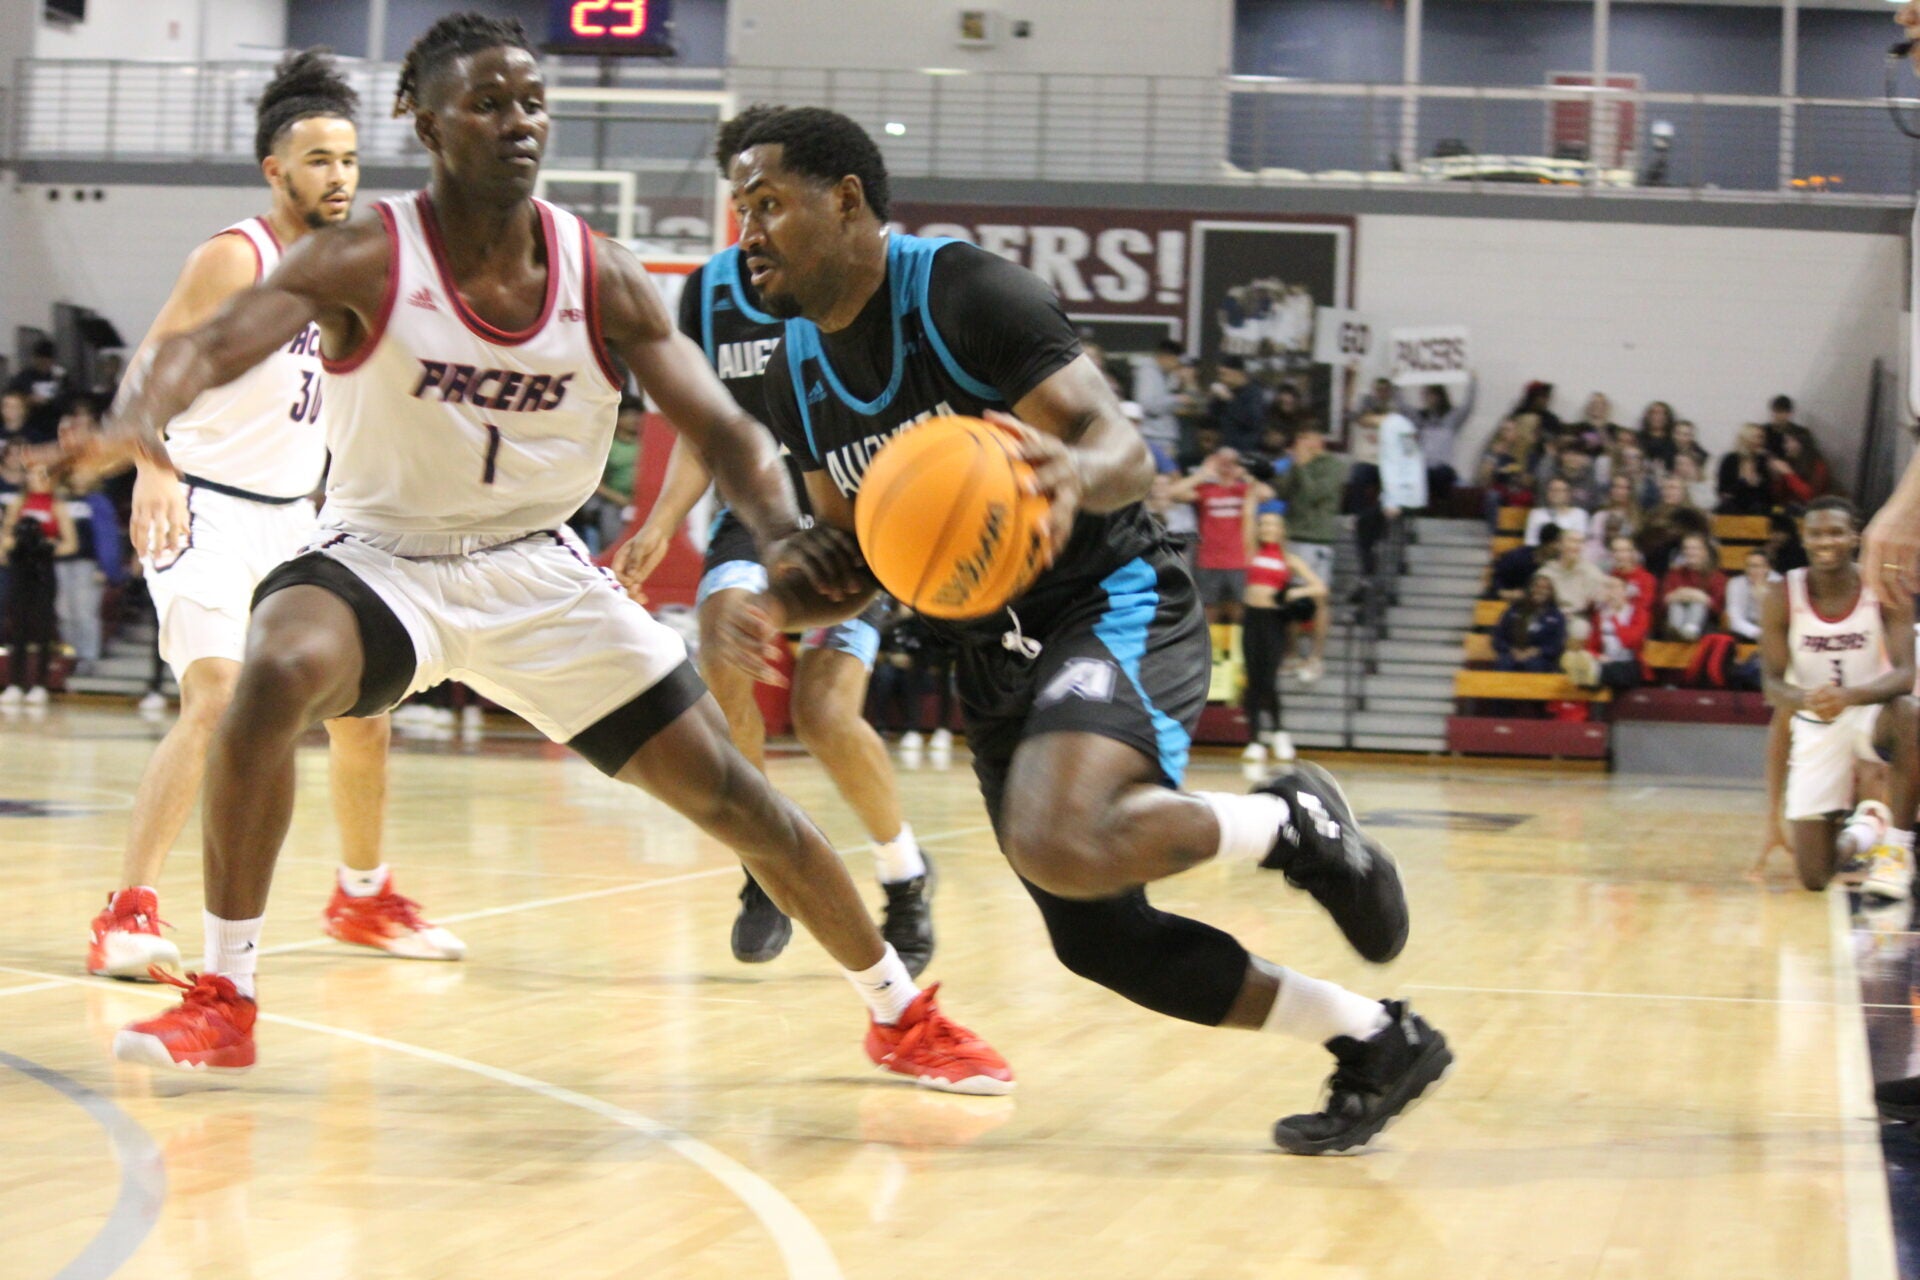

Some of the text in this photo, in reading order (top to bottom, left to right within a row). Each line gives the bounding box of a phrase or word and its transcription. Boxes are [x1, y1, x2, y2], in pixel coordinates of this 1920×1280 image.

[569, 0, 648, 37] 23
[410, 357, 576, 412] PACERS
[482, 422, 500, 485] 1
